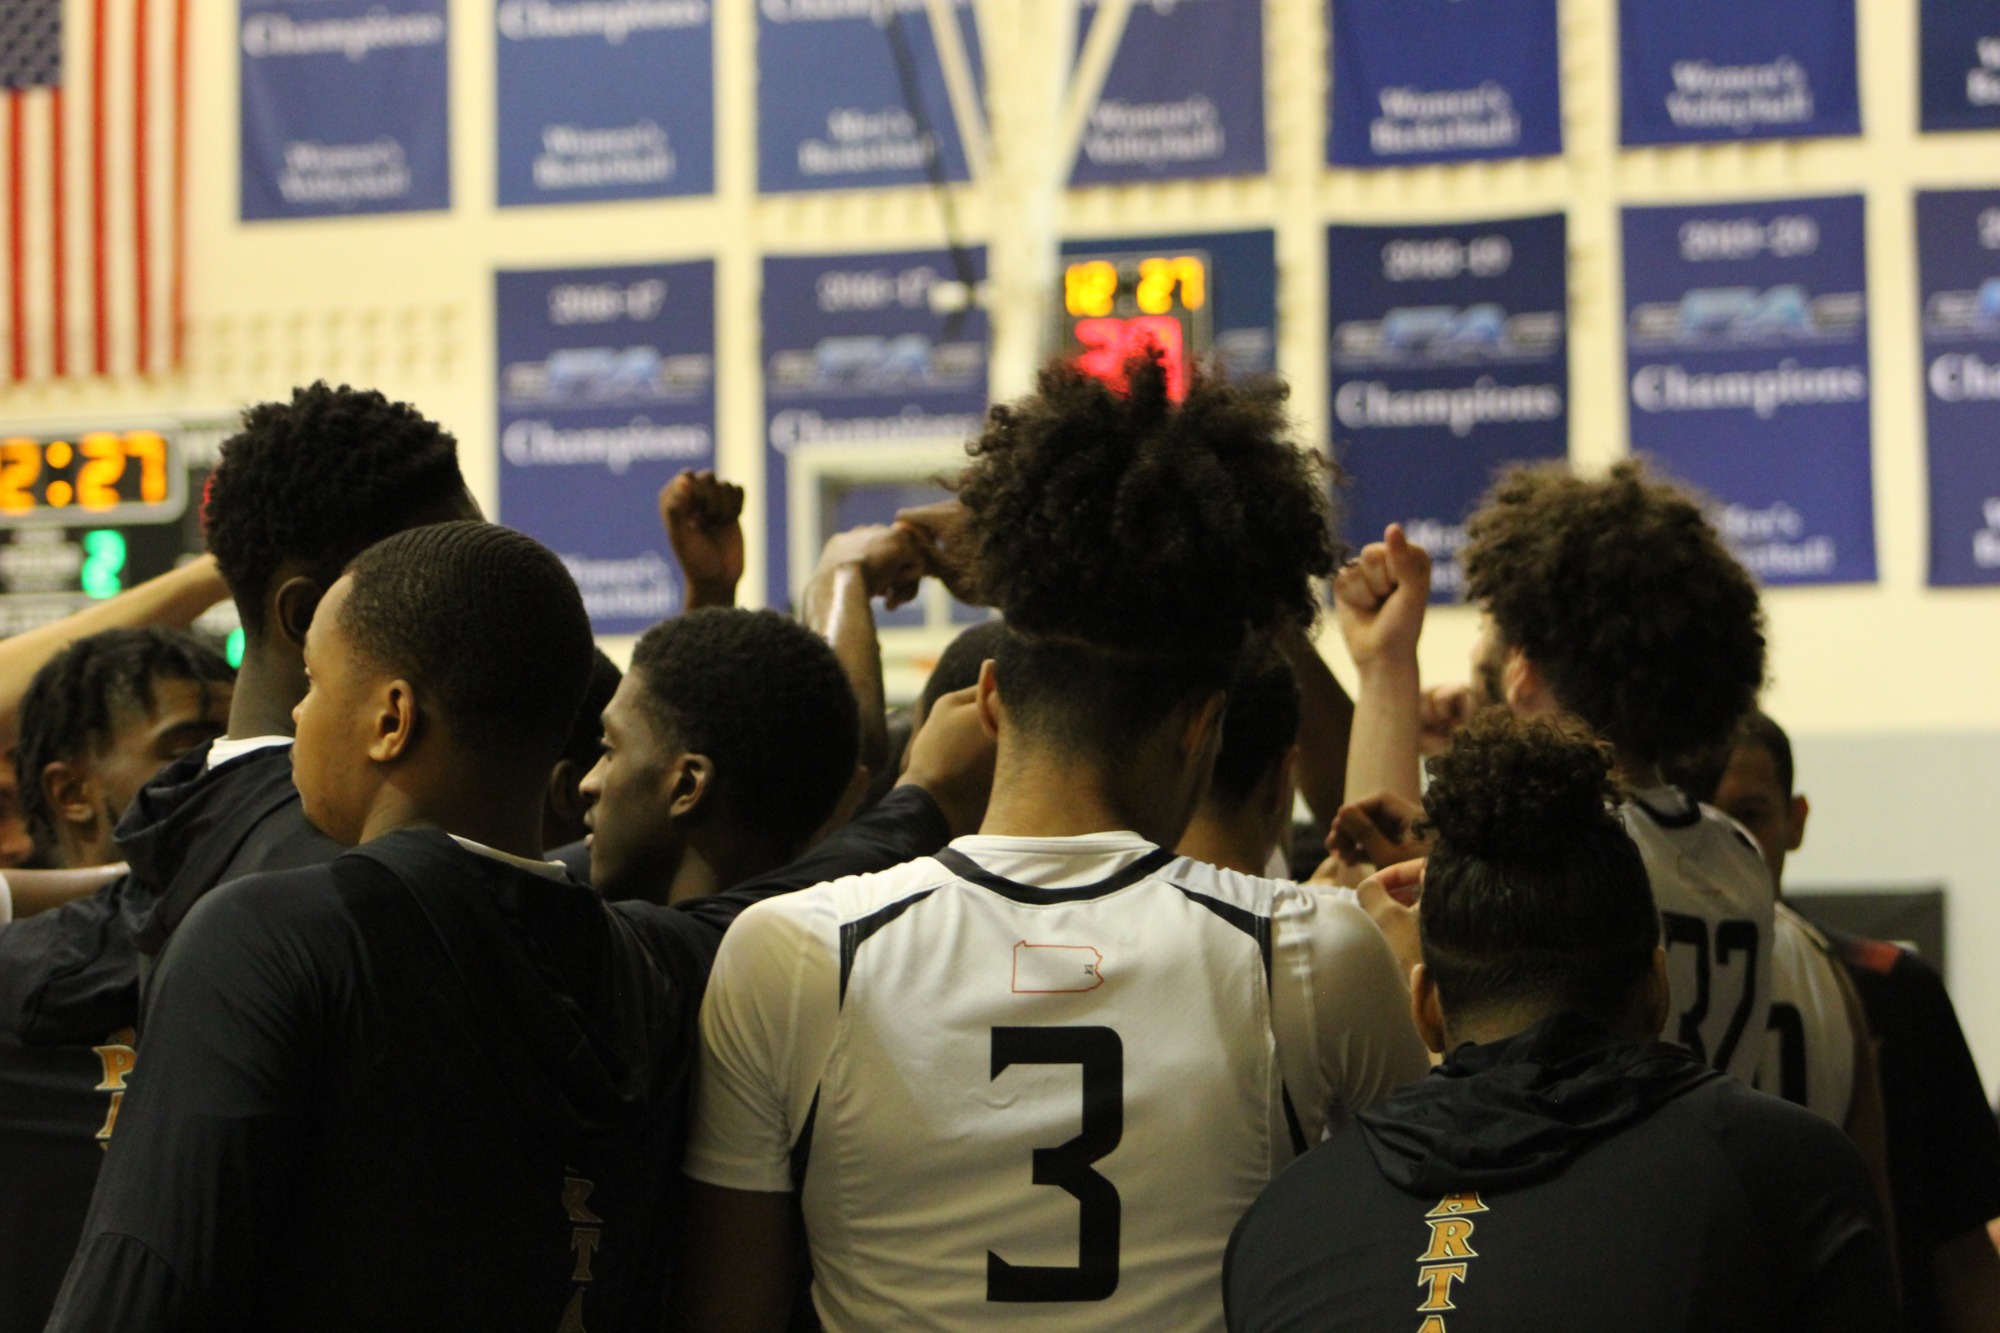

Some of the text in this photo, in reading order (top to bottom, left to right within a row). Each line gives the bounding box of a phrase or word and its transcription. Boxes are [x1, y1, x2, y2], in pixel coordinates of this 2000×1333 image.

[1337, 377, 1561, 436] Champions
[1633, 358, 1866, 419] Champions
[504, 417, 711, 473] Champions
[987, 1025, 1123, 1302] 3
